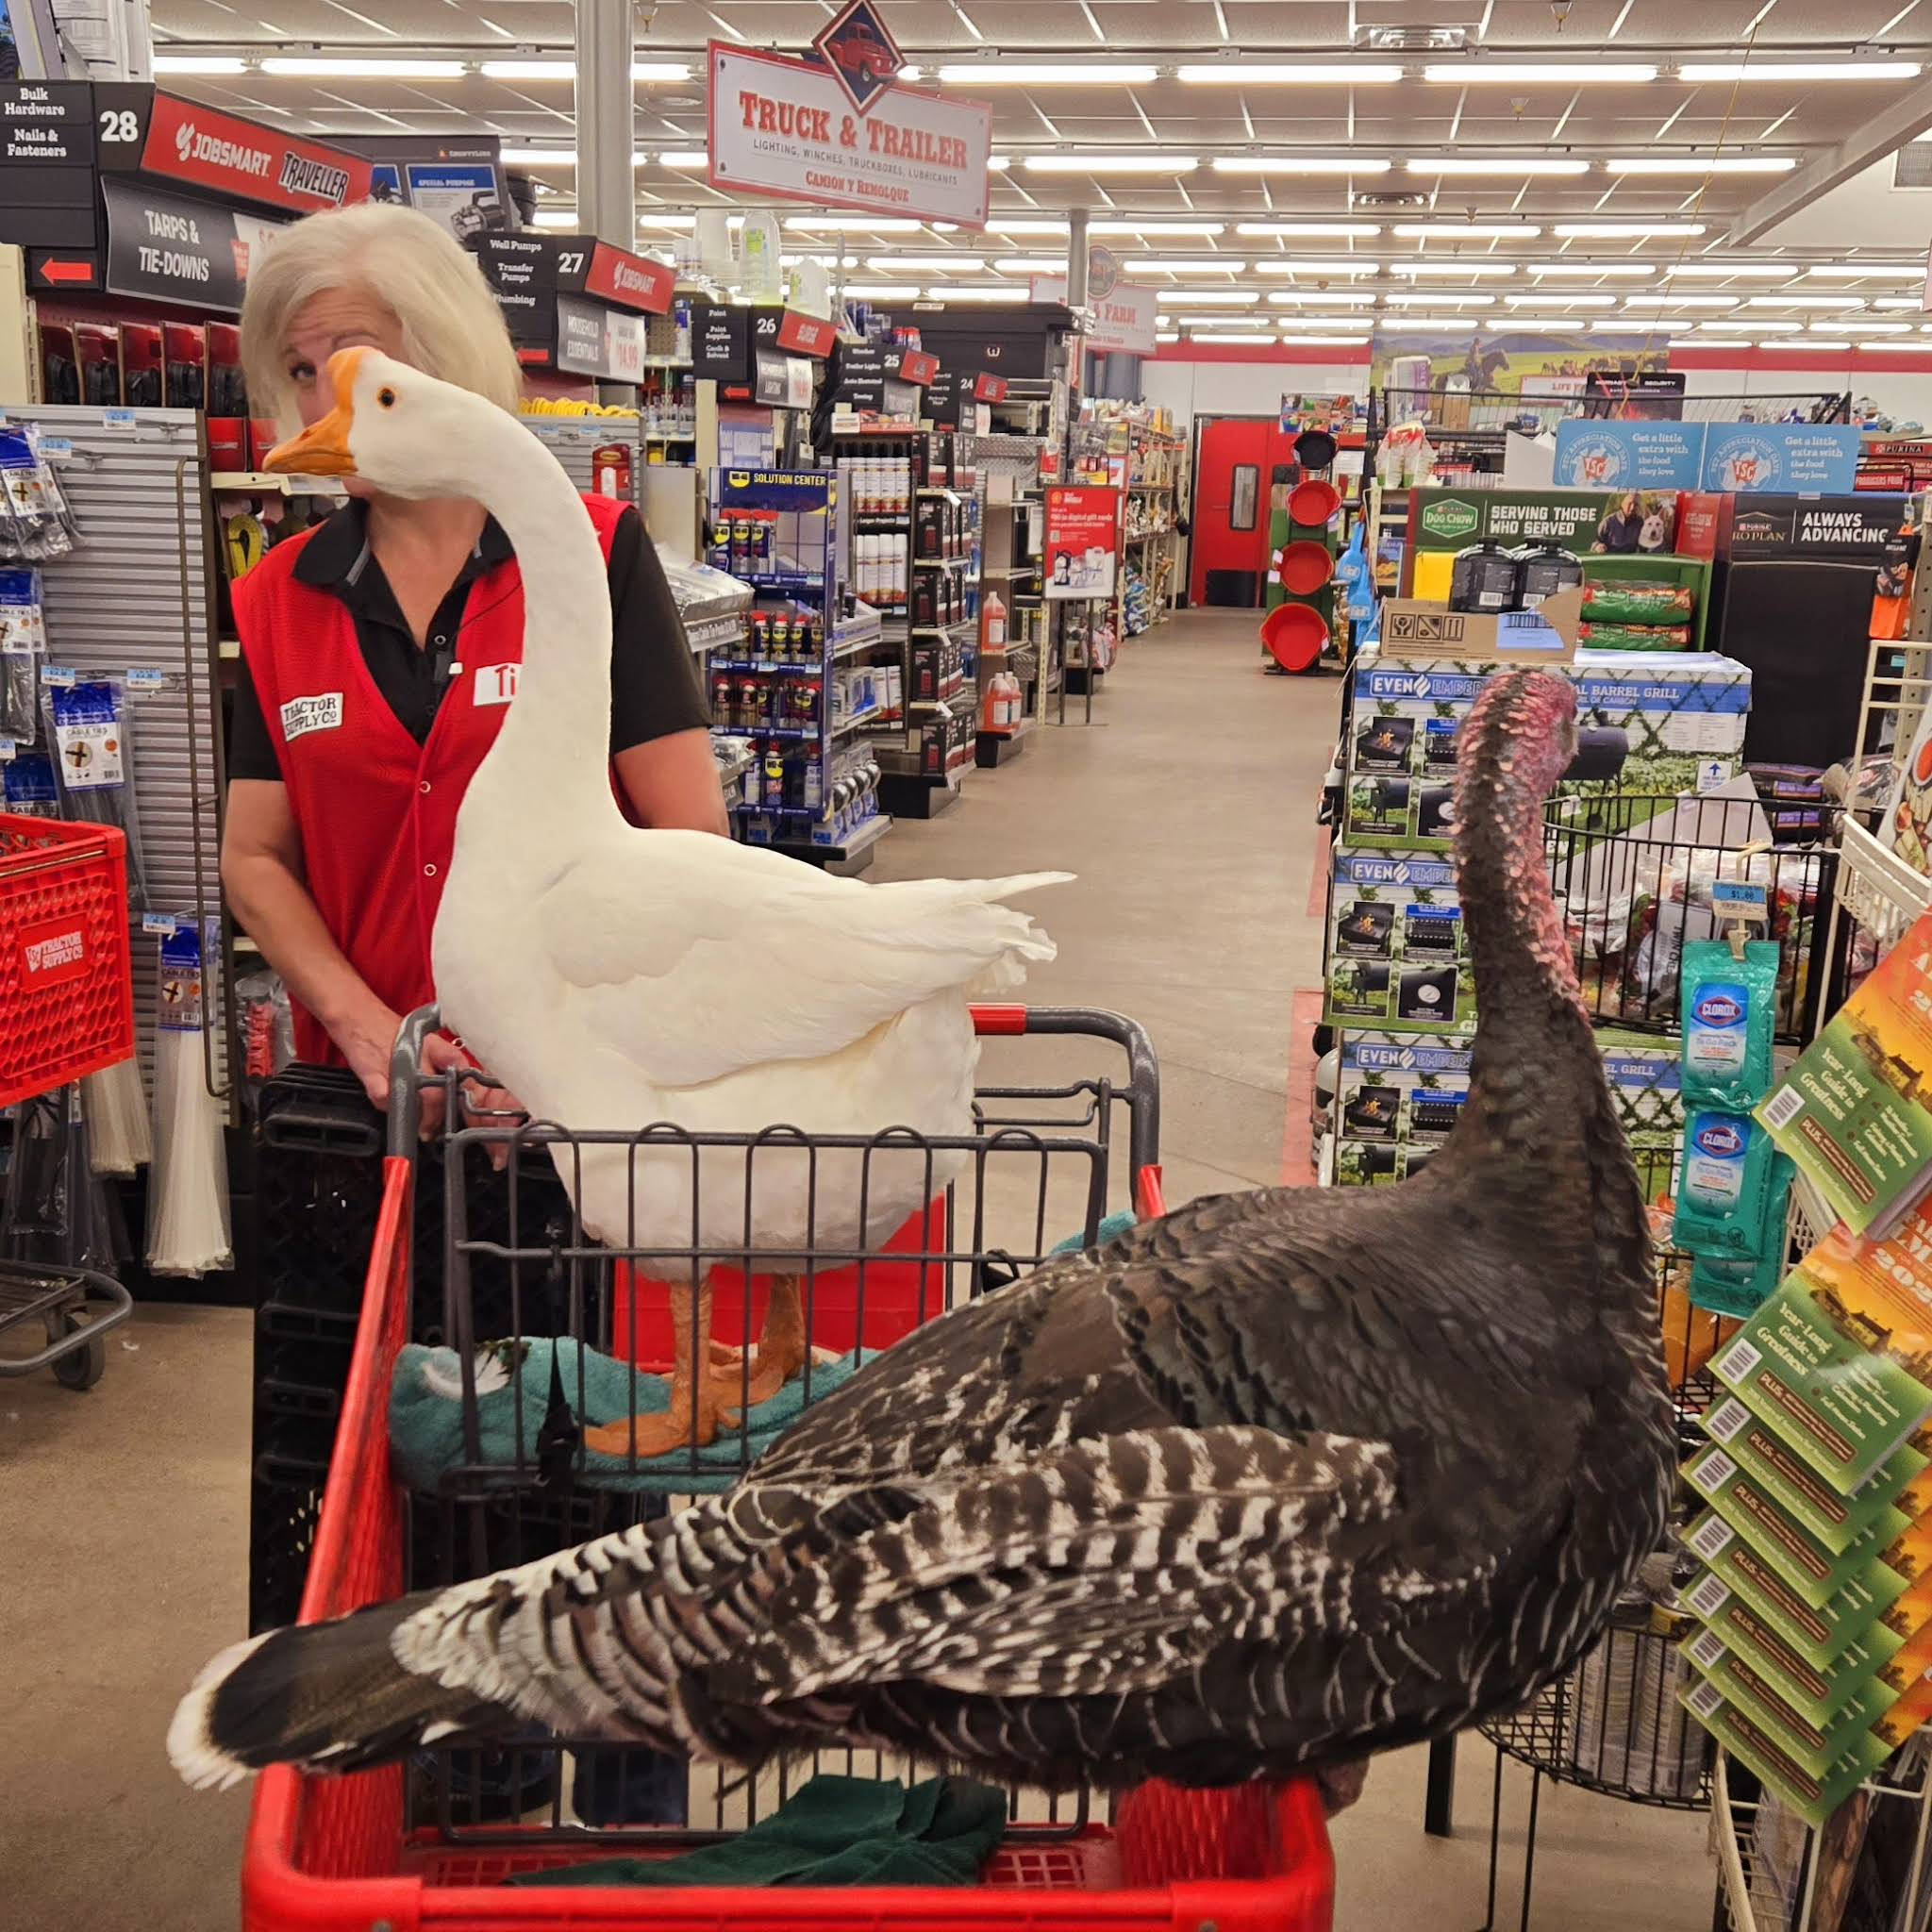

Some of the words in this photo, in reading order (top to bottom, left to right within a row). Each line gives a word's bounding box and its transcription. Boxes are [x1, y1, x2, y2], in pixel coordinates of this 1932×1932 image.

[20, 88, 48, 101] Bulk
[5, 102, 65, 116] Hardware
[14, 128, 46, 142] Nails
[49, 129, 58, 142] &
[100, 111, 138, 142] 28
[740, 91, 831, 144] TRUCK
[840, 115, 857, 149] &
[867, 118, 967, 169] TRAILER
[7, 143, 67, 158] Fasteners
[192, 134, 272, 176] JOBSMART
[279, 151, 349, 206] TRAVELLER
[754, 139, 800, 158] LIGHTING,
[804, 148, 845, 165] WINCHES,
[908, 170, 958, 186] LUBRICANTS
[806, 171, 845, 192] CAMION
[848, 179, 856, 192] Y
[857, 179, 908, 202] REMOLQUE
[144, 209, 188, 242] TARPS
[188, 220, 199, 244] &
[490, 240, 509, 250] Well
[511, 241, 541, 253] Pumps
[139, 246, 209, 282] TIE-DOWNS
[498, 263, 534, 273] Transfer
[558, 253, 584, 273] 27
[502, 273, 530, 283] Pumps
[757, 318, 776, 333] 26
[884, 355, 900, 368] 25
[960, 378, 974, 390] 24
[1632, 434, 1649, 442] Get
[1658, 433, 1683, 443] little
[1785, 437, 1803, 445] Get
[1811, 437, 1838, 445] little
[1638, 445, 1664, 454] extra
[1666, 445, 1689, 454] with
[1790, 448, 1818, 457] extra
[1819, 448, 1843, 458] with
[1886, 444, 1924, 453] PURINA
[1585, 458, 1606, 475] TSC
[1652, 457, 1671, 465] food
[1806, 459, 1825, 469] food
[1638, 467, 1657, 475] they
[1736, 461, 1755, 480] TSC
[1790, 472, 1809, 480] they
[754, 473, 793, 485] SOLUTION
[794, 475, 826, 486] CENTER
[1426, 511, 1445, 524] DOG
[1446, 513, 1474, 525] CHOW
[1491, 505, 1548, 520] SERVING
[1554, 508, 1596, 522] THOSE
[1802, 512, 1862, 527] ALWAYS
[1490, 521, 1519, 534] WHO
[1524, 522, 1575, 536] SERVED
[1732, 531, 1750, 541] RO
[1751, 531, 1785, 541] PLAN
[1801, 526, 1889, 543] ADVANCING
[494, 665, 516, 696] Ti
[1374, 678, 1413, 693] EVEN
[1432, 682, 1484, 698] EMBER
[1591, 686, 1640, 697] BARREL
[1644, 688, 1680, 699] GRILL
[284, 697, 336, 721] TRACTOR
[1355, 864, 1392, 879] EVEN
[1410, 867, 1455, 881] EMBE
[1702, 1004, 1737, 1017] CLOROX
[1359, 1050, 1398, 1067] EVEN
[1622, 1064, 1656, 1075] GRILL
[1821, 1047, 1868, 1097] Year-Long
[1801, 1072, 1846, 1120] Greatness
[1821, 1070, 1848, 1098] Guide
[1844, 1097, 1856, 1108] to
[1703, 1132, 1736, 1149] CLOROX
[1870, 1247, 1932, 1311] 202
[1777, 1302, 1831, 1354] Year-Long
[1757, 1326, 1808, 1375] Greatness
[1778, 1324, 1809, 1354] Guide
[1807, 1353, 1818, 1364] to
[1761, 1374, 1783, 1396] PLUS:
[1751, 1434, 1774, 1456] PLUS:
[1736, 1486, 1758, 1508] PLUS:
